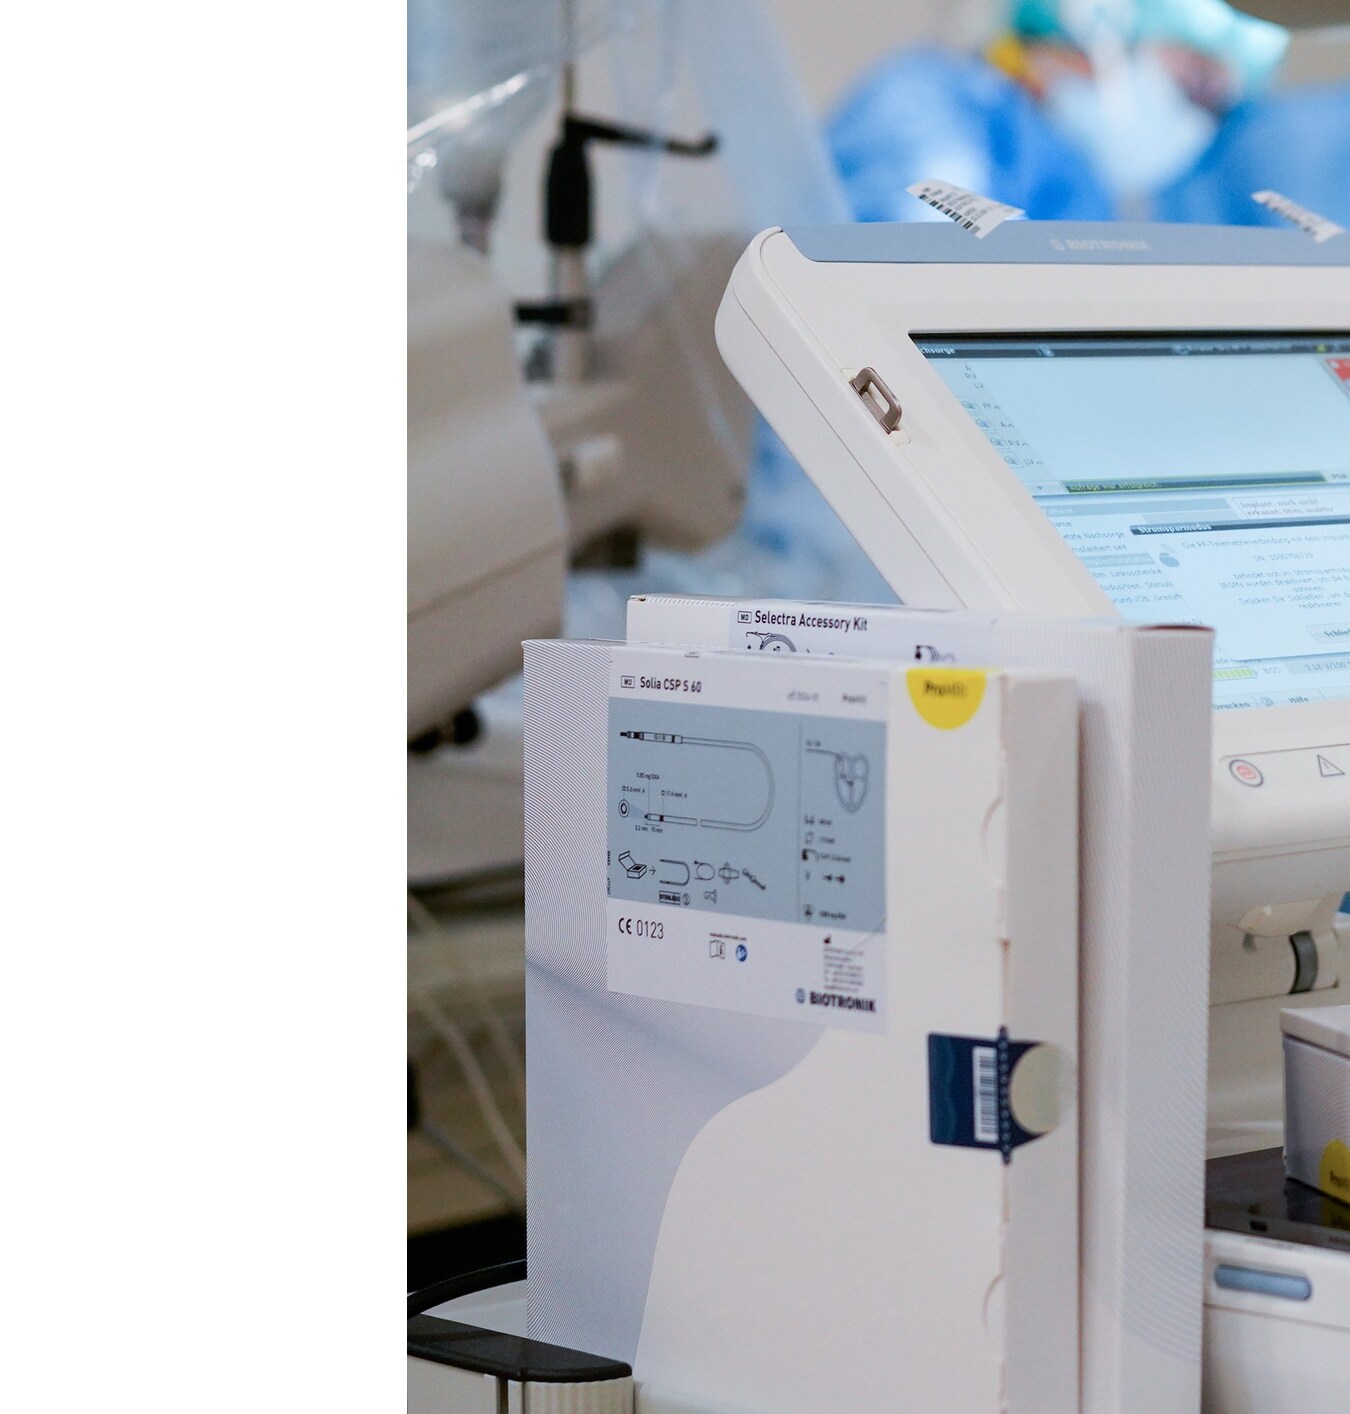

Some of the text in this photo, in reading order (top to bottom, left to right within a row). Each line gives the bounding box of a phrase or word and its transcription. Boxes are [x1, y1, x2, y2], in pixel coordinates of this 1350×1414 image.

[1083, 531, 1125, 540] Nachsorge
[1138, 523, 1213, 535] Stromsparmodus
[1182, 541, 1196, 549] Die
[739, 610, 868, 633] MD Selectra Accessory Kit
[640, 676, 662, 690] Solia
[663, 678, 682, 691] CSP
[683, 680, 689, 692] S
[691, 681, 702, 693] 60
[1288, 695, 1310, 704] Hilfe
[618, 917, 664, 940] CE 0123
[810, 990, 877, 1013] BIOTRONIK
